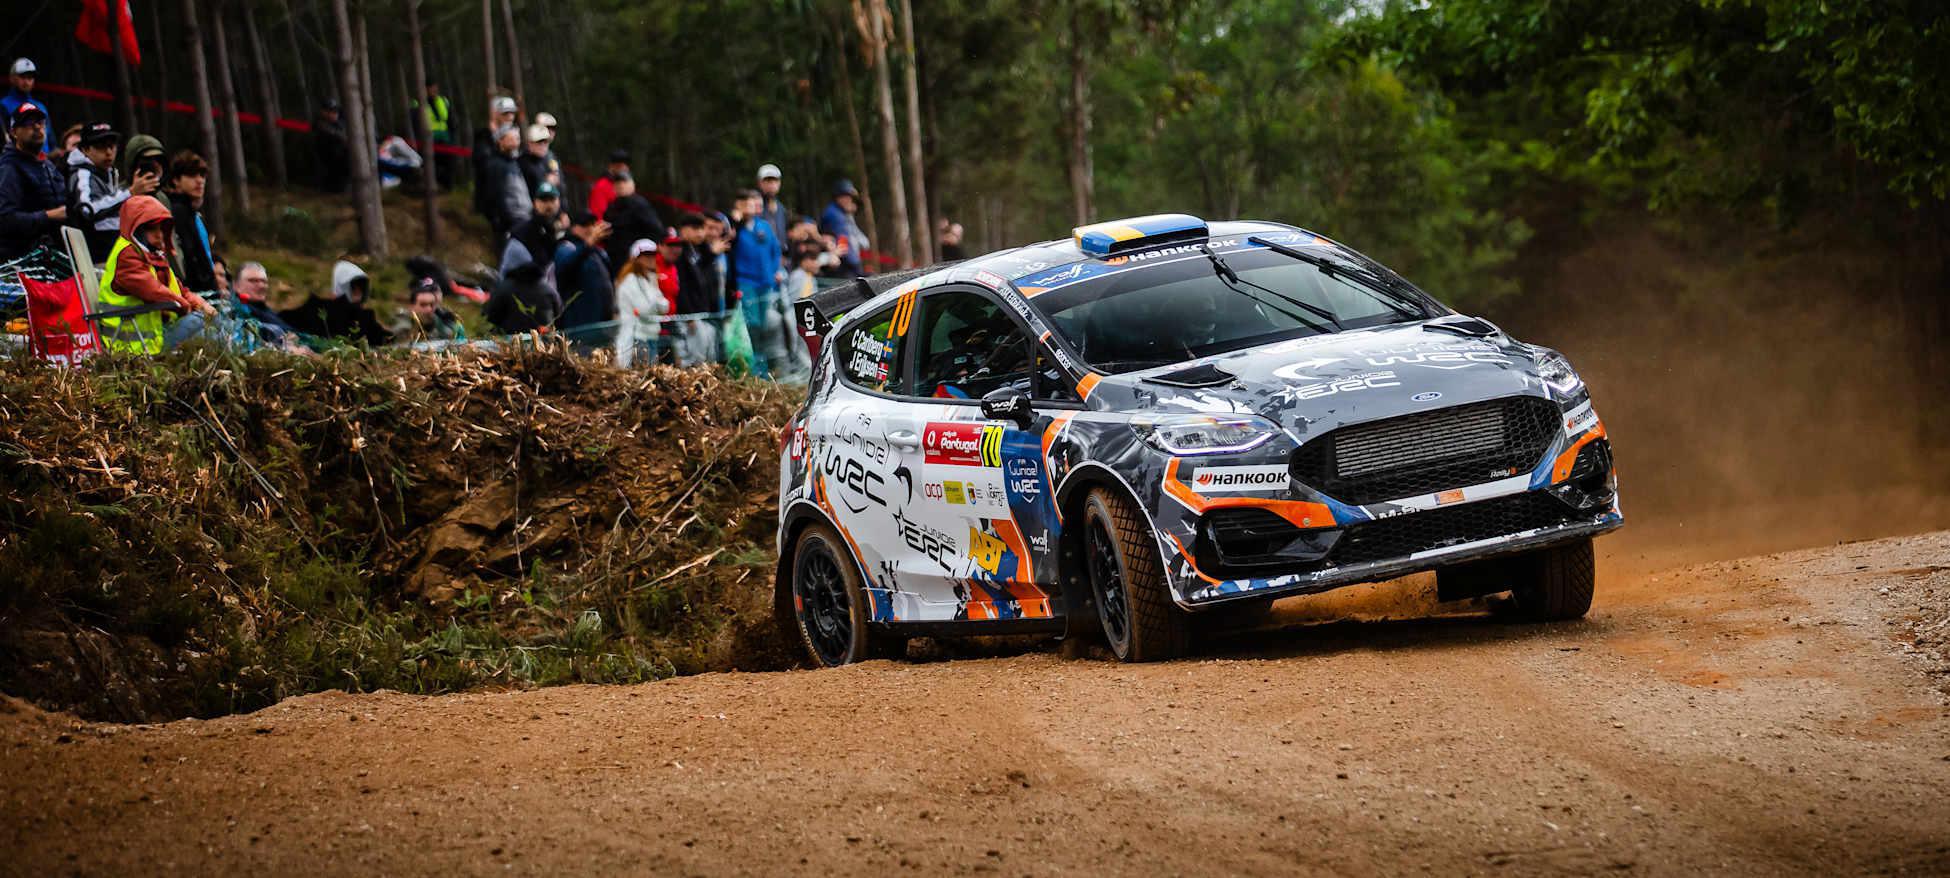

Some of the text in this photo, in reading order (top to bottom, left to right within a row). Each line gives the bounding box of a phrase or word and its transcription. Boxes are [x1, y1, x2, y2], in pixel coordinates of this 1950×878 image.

[1032, 263, 1084, 285] wolf
[887, 287, 917, 339] 70
[851, 329, 859, 348] C
[1055, 347, 1072, 369] sparco
[1366, 351, 1513, 367] WRC
[1295, 375, 1401, 400] ERC
[990, 395, 1019, 412] wolf
[941, 438, 979, 454] Portugal
[982, 426, 1003, 467] 70
[825, 445, 888, 507] WRC
[1011, 479, 1040, 494] WRC
[1213, 472, 1287, 485] HANKOOK
[903, 525, 956, 573] ERC
